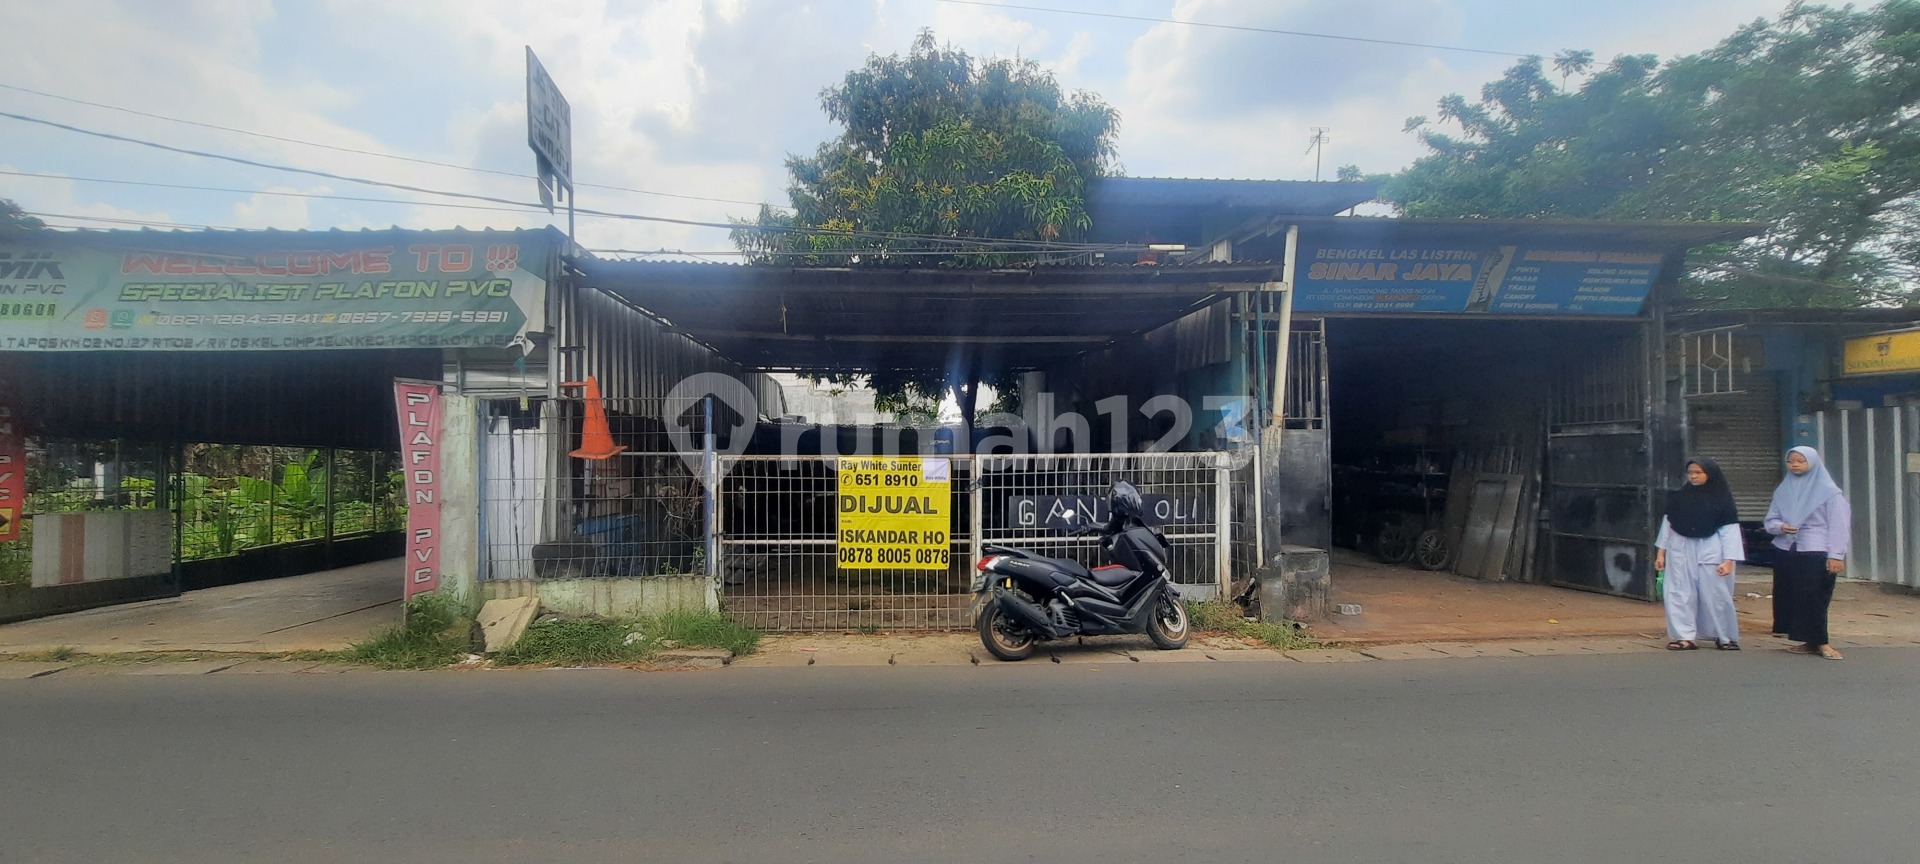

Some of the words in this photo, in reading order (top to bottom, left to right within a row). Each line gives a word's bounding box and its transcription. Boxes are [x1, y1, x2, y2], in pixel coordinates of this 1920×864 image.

[408, 244, 473, 273] TO
[1316, 248, 1385, 260] BENGKEL
[1389, 249, 1418, 260] LAS
[1421, 249, 1478, 261] LISTRIK
[1307, 261, 1398, 281] SINAR
[1402, 262, 1473, 281] JAYA
[22, 284, 67, 295] PVC
[118, 282, 311, 302] SPECIALIST
[313, 280, 439, 301] PLAFON
[444, 278, 513, 299] PVC
[0, 303, 56, 318] BOGOR
[407, 392, 434, 505] PLAFON
[841, 460, 858, 472] Ray
[861, 460, 888, 472] White
[891, 460, 921, 472] Sunter
[855, 474, 879, 486] 651
[884, 474, 918, 487] 8910
[840, 494, 938, 515] DIJUAL
[1155, 498, 1197, 519] OLI
[840, 529, 918, 545] ISKANDAR
[923, 530, 945, 545] HO
[413, 528, 434, 584] PVC
[839, 547, 873, 563] 0878
[877, 547, 911, 564] 8005
[915, 548, 949, 564] 0878
